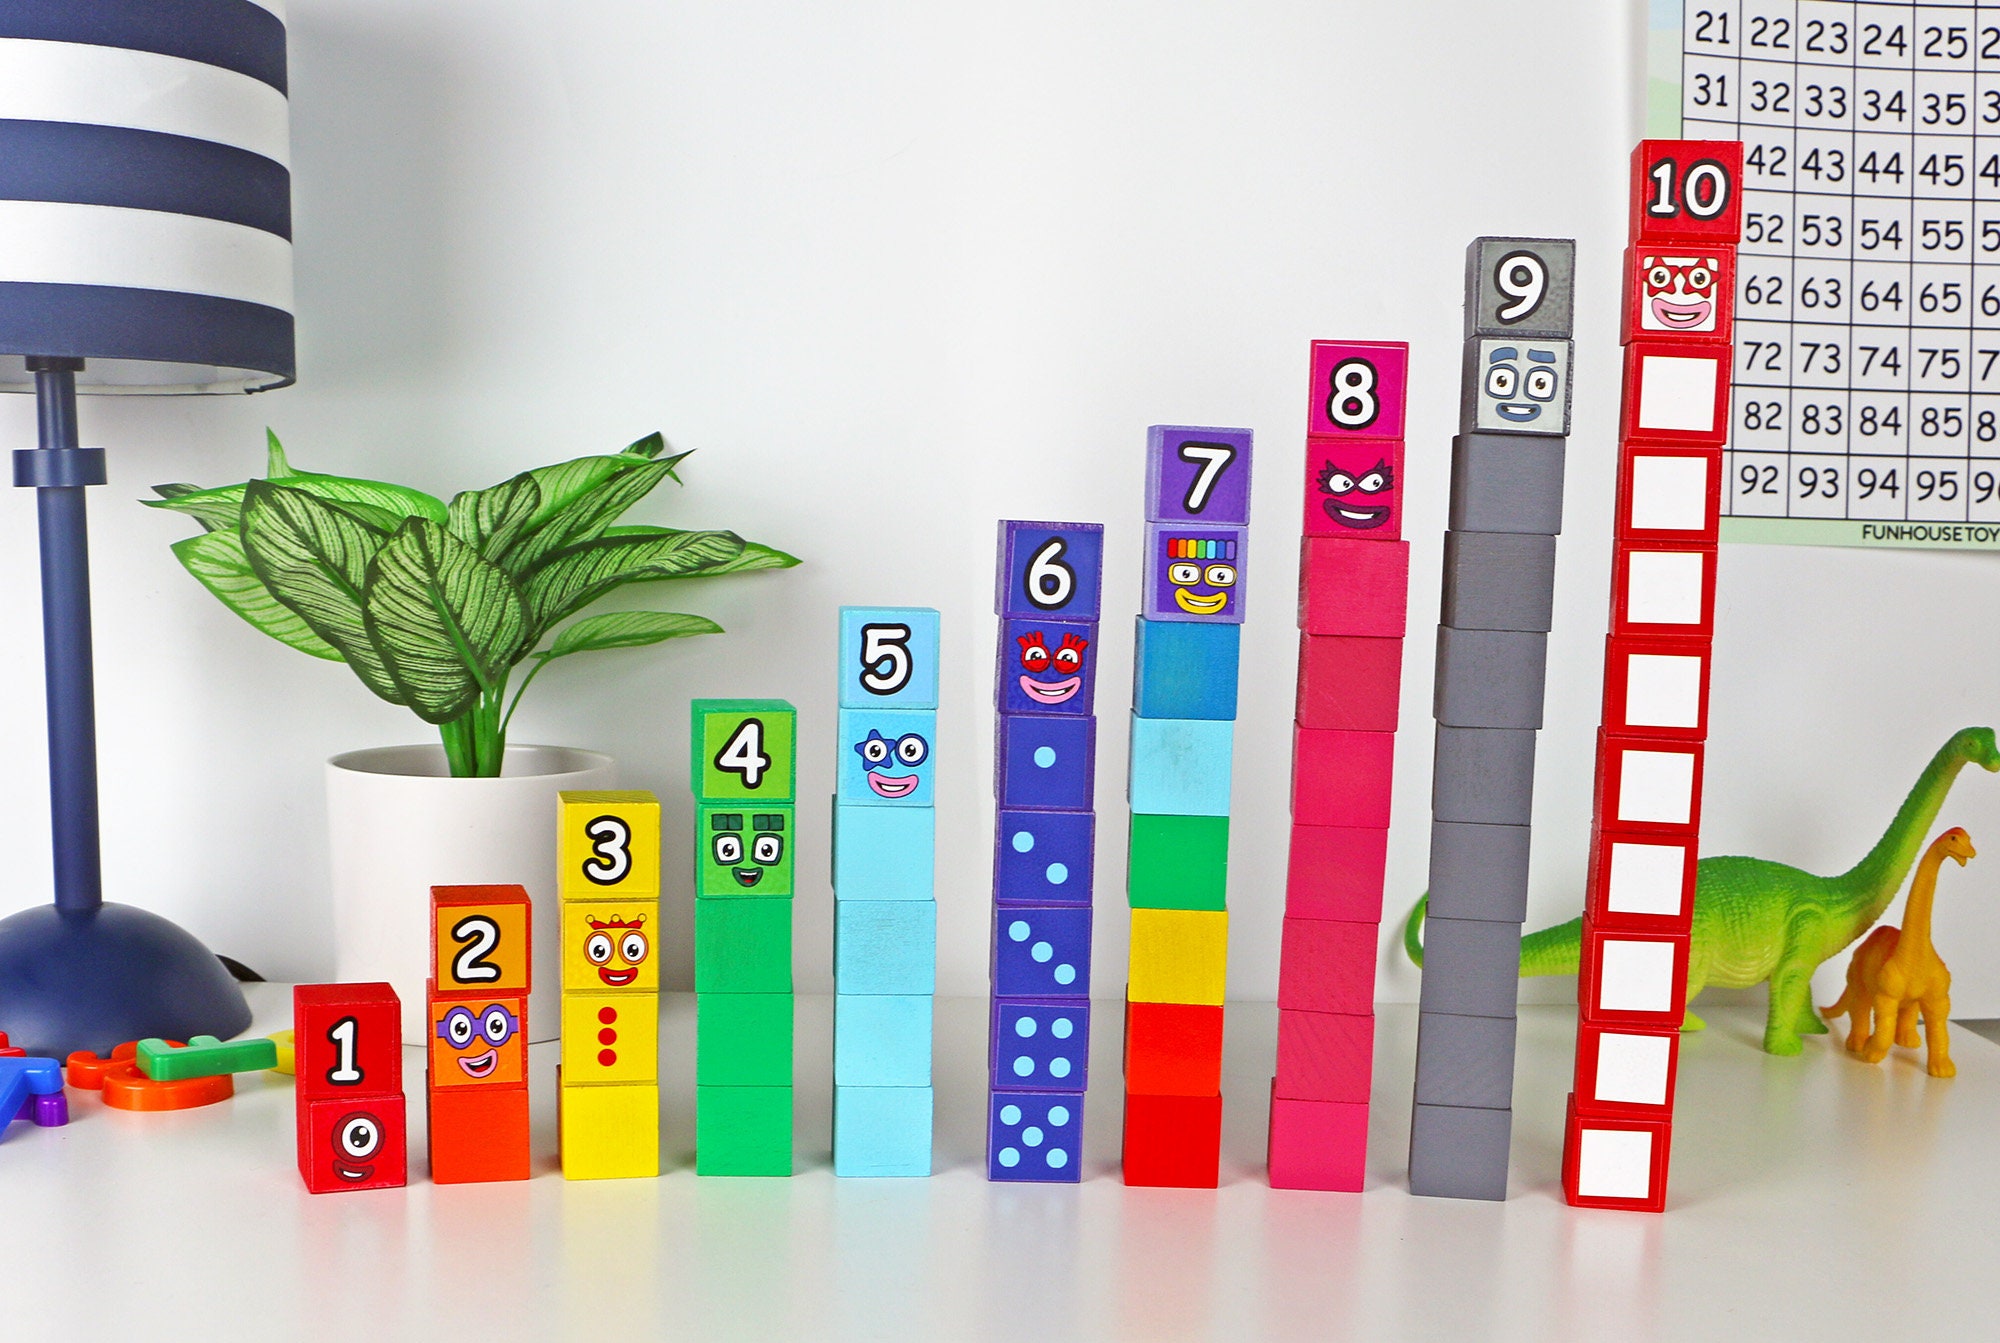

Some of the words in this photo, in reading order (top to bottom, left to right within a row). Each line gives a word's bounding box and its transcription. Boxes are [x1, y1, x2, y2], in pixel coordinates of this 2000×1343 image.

[1696, 11, 1729, 44] 21
[1751, 17, 1789, 48] 22
[1807, 20, 1847, 54] 23
[1864, 24, 1907, 56] 24
[1924, 27, 1967, 58] 25
[1694, 74, 1727, 106] 31
[1751, 81, 1789, 112] 32
[1805, 85, 1846, 118] 33
[1863, 90, 1906, 122] 34
[1923, 94, 1966, 125] 35
[1648, 158, 1730, 220] 10
[1746, 145, 1786, 176] 42
[1801, 148, 1844, 182] 43
[1859, 151, 1904, 184] 44
[1919, 154, 1964, 186] 45
[1747, 213, 1783, 243] 52
[1803, 215, 1842, 246] 53
[1861, 220, 1902, 250] 54
[1922, 220, 1963, 250] 55
[1494, 251, 1548, 325] 9
[1745, 275, 1782, 304] 62
[1802, 277, 1841, 308] 63
[1861, 281, 1902, 311] 64
[1920, 283, 1961, 313] 65
[1744, 342, 1781, 370] 72
[1800, 343, 1840, 373] 73
[1859, 346, 1901, 376] 74
[1918, 349, 1960, 379] 75
[1327, 358, 1379, 429] 8
[1745, 402, 1782, 430] 82
[1802, 404, 1842, 435] 83
[1860, 406, 1901, 436] 84
[1921, 408, 1962, 437] 85
[1179, 442, 1234, 514] 7
[1741, 465, 1778, 494] 92
[1799, 467, 1838, 498] 93
[1858, 469, 1899, 499] 94
[1917, 471, 1958, 501] 95
[1974, 471, 2000, 503] 9
[1027, 537, 1076, 610] 6
[860, 624, 912, 695] 5
[714, 718, 771, 789] 4
[583, 815, 631, 885] 3
[452, 915, 501, 983] 2
[327, 1017, 364, 1085] 1
